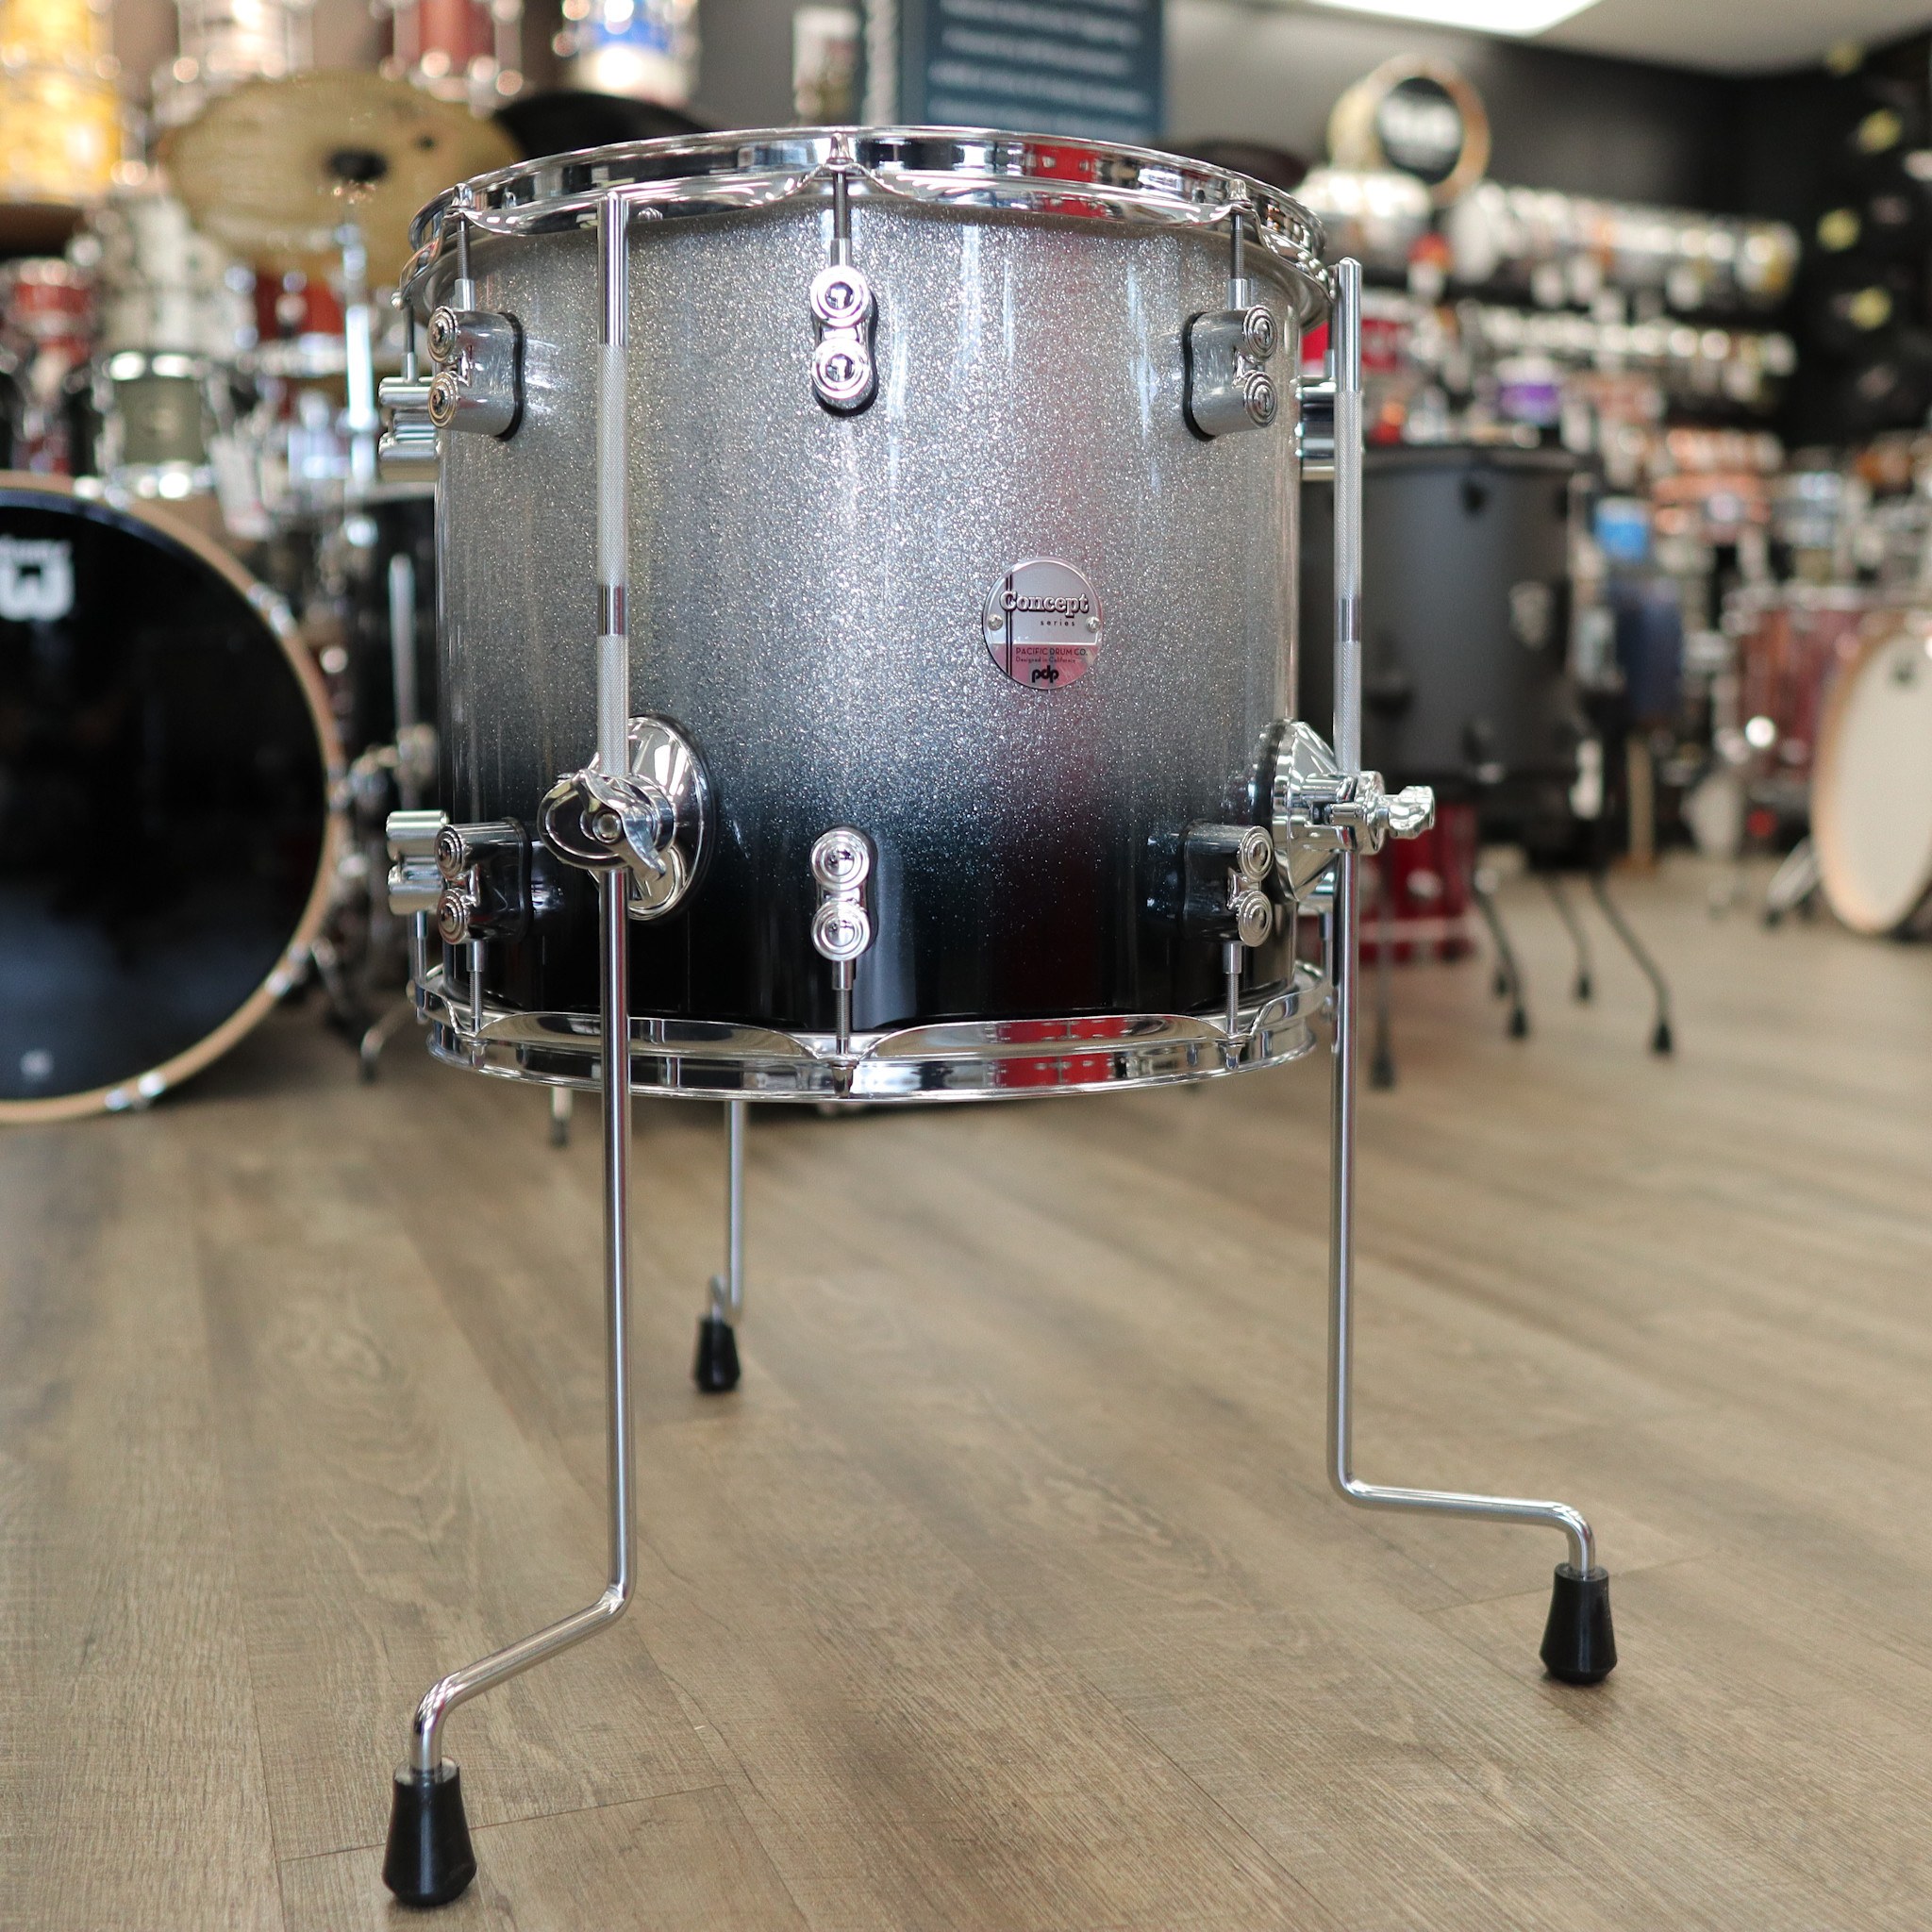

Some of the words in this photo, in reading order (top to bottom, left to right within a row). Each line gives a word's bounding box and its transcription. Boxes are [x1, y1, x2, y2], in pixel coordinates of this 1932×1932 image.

[1000, 591, 1089, 618] Concept
[1015, 647, 1048, 656] PACIFIC
[1031, 665, 1059, 683] pdp
